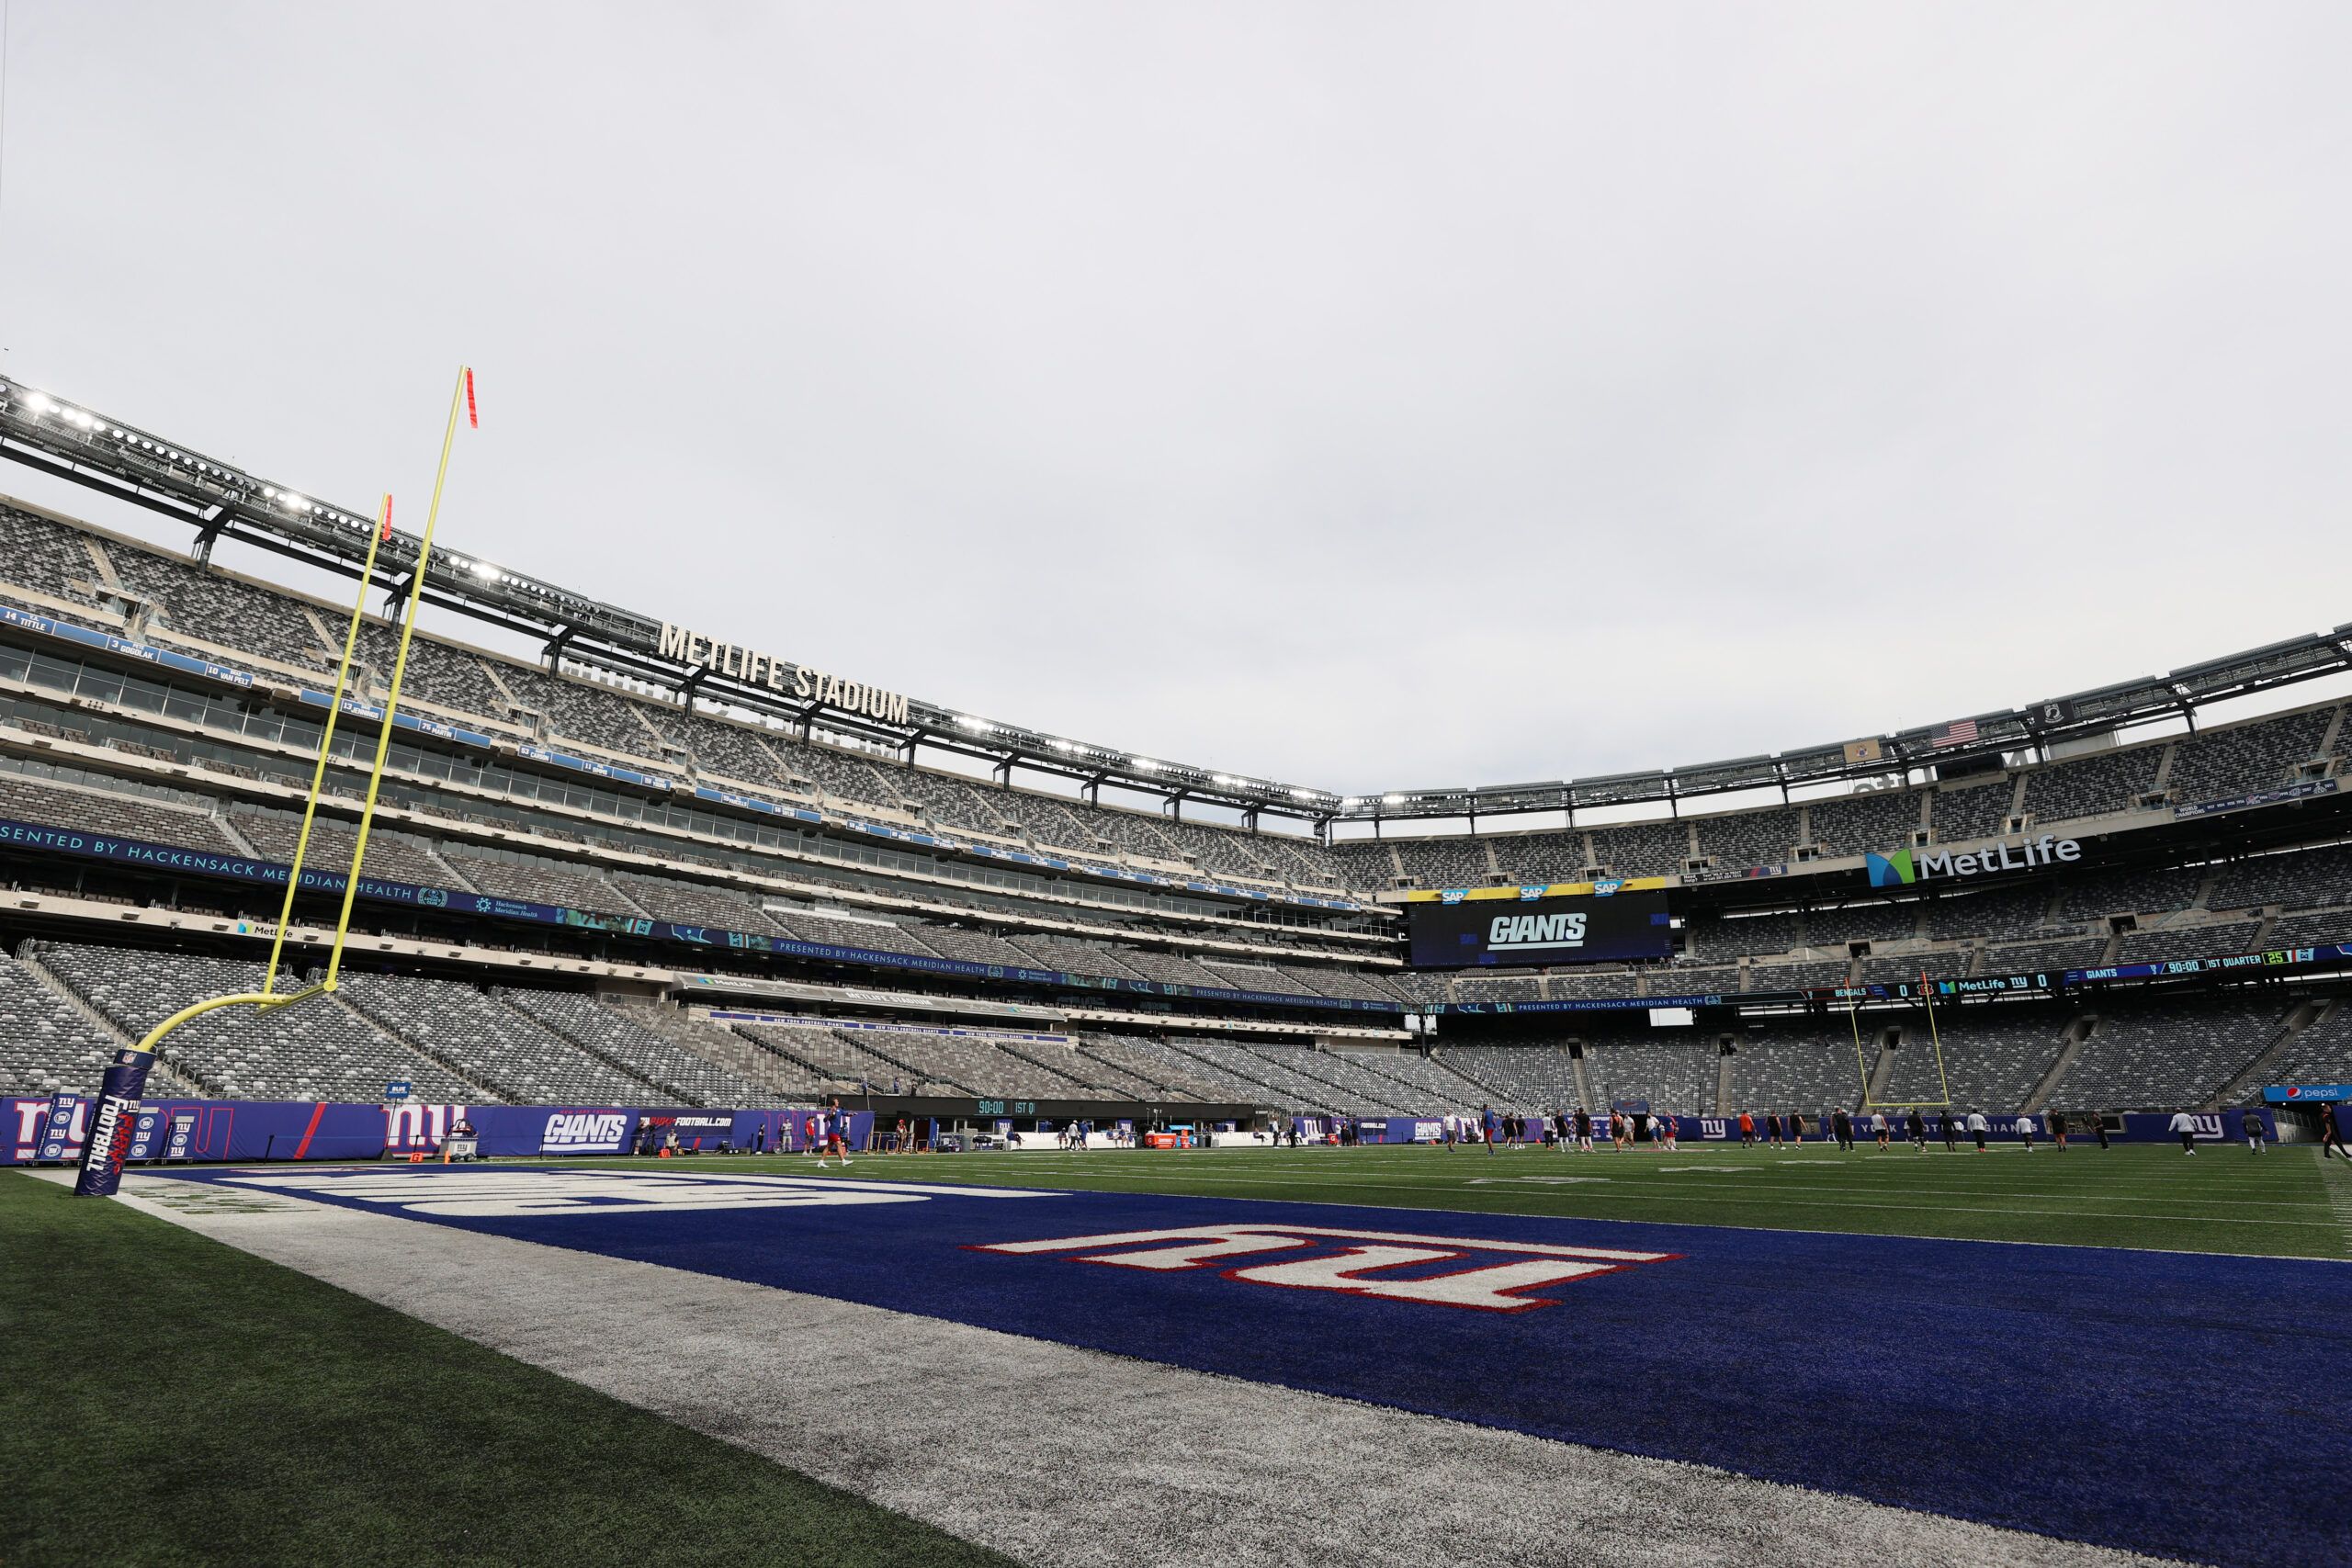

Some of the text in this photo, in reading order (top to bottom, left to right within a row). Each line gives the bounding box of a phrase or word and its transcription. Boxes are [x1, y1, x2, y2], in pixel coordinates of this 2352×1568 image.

[5, 611, 17, 621] 14
[20, 617, 46, 631] TITTLE
[111, 639, 119, 648] 3
[119, 645, 153, 660] GOGOLAK
[208, 666, 219, 675] 10
[658, 621, 909, 725] METLIFE STADIUM
[220, 671, 250, 685] VAN PELT
[343, 702, 352, 710] 13
[2175, 808, 2205, 818] CHAMPIONS
[2178, 805, 2198, 813] WORLD
[0, 826, 83, 849] SENTED
[95, 840, 118, 854] BY
[128, 846, 254, 876] HACKENSACK
[355, 882, 412, 899] HEALTH
[1919, 833, 2082, 880] MetLife
[1521, 888, 1544, 898] SAP
[1595, 884, 1618, 894] SAP
[1442, 891, 1464, 902] SAP
[254, 925, 293, 938] MetLfe
[1488, 912, 1587, 943] GIANTS
[780, 942, 831, 956] PRESENTED
[835, 949, 846, 958] BY
[850, 952, 909, 965] HACKENSACK
[911, 959, 952, 971] MERIDIAN
[955, 964, 985, 975] HEALTH
[1835, 987, 1867, 998] BENGALS
[1899, 985, 1908, 998] 0
[1959, 978, 2006, 991] MetLife
[2009, 976, 2028, 989] ny
[2038, 975, 2047, 987] 0
[2086, 969, 2118, 979] GIANTS
[2168, 961, 2199, 973] 90:00
[2208, 959, 2221, 968] 1ST
[2222, 954, 2262, 968] QUARTER
[2267, 953, 2283, 964] 25
[845, 991, 933, 1006] METLIFE STADIUM
[1196, 989, 1231, 998] PRESENTED
[1242, 993, 1283, 1003] HACKENSACK
[1284, 997, 1314, 1005] MERIDIAN
[1316, 999, 1338, 1008] HEALTH
[1519, 997, 1702, 1011] PRESENTED BY HACKENSACK MERIDIAN HEALTH
[2304, 1089, 2338, 1100] pepsi
[58, 1097, 75, 1108] ny
[978, 1100, 1004, 1114] 90:00
[1015, 1102, 1026, 1113] 1ST
[175, 1122, 191, 1133] ny
[544, 1113, 628, 1144] GIANTS
[674, 1117, 732, 1127] FOOTBALL.COM
[1985, 1123, 2039, 1133] GIANS
[50, 1129, 67, 1140] ny
[86, 1095, 129, 1171] FOOTBALL
[1415, 1122, 1442, 1137] GIANTS
[1701, 1119, 1725, 1139] ny
[135, 1132, 151, 1142] ny
[170, 1146, 185, 1156] ny
